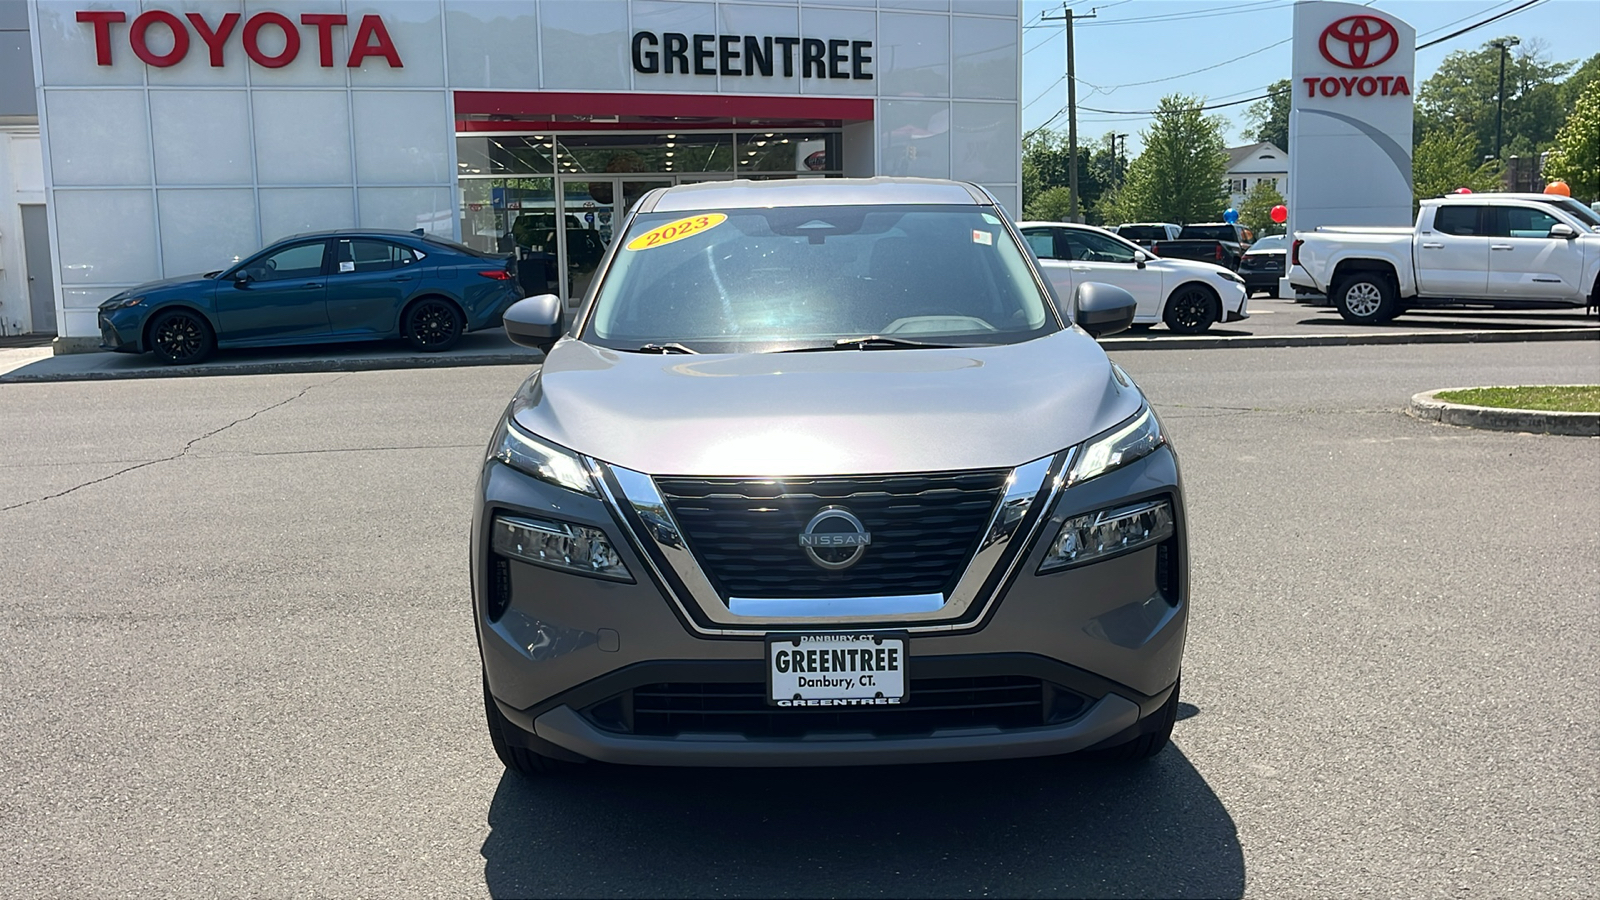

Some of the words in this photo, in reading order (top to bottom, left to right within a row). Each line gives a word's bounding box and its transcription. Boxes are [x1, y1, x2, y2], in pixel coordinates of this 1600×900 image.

[75, 10, 404, 69] TOYOTA
[632, 31, 873, 80] GREENTREE
[1303, 76, 1411, 98] TOYOTA
[646, 217, 709, 247] 2023
[801, 534, 869, 545] NISSAN
[775, 648, 899, 673] GREENTREE
[798, 675, 855, 690] Danbury,
[859, 675, 876, 686] CT.
[777, 698, 900, 706] GREENTREE
